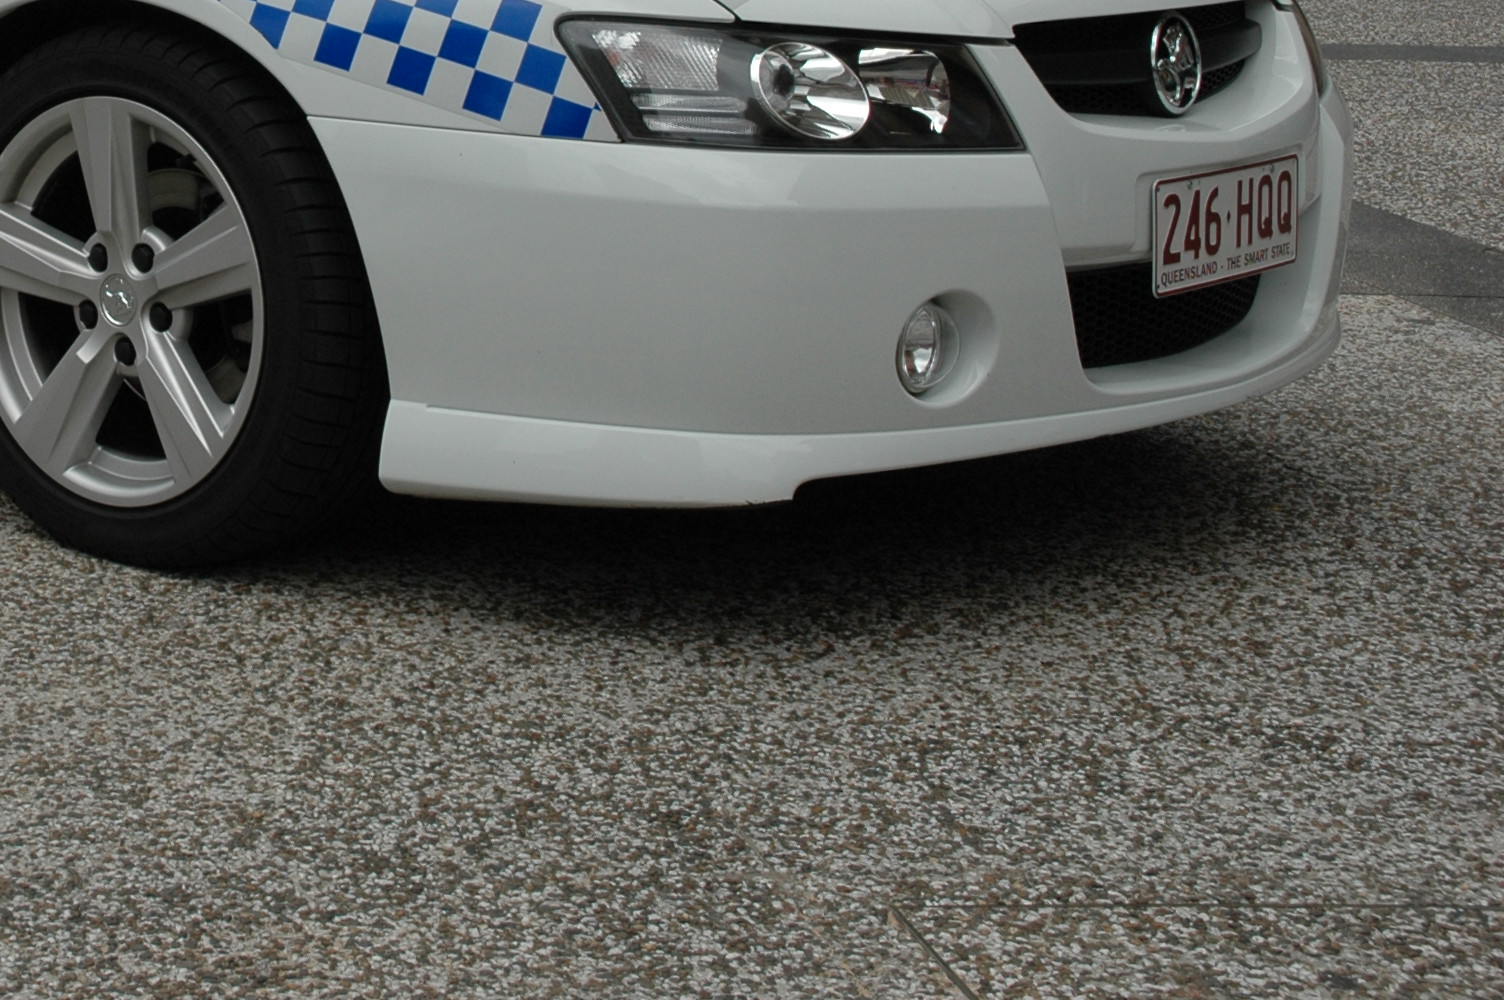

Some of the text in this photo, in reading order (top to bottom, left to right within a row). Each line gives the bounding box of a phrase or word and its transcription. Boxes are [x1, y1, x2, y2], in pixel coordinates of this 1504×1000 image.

[1163, 186, 1221, 265] 246
[1161, 242, 1290, 287] QUEENSLAND THE SMART STATE
